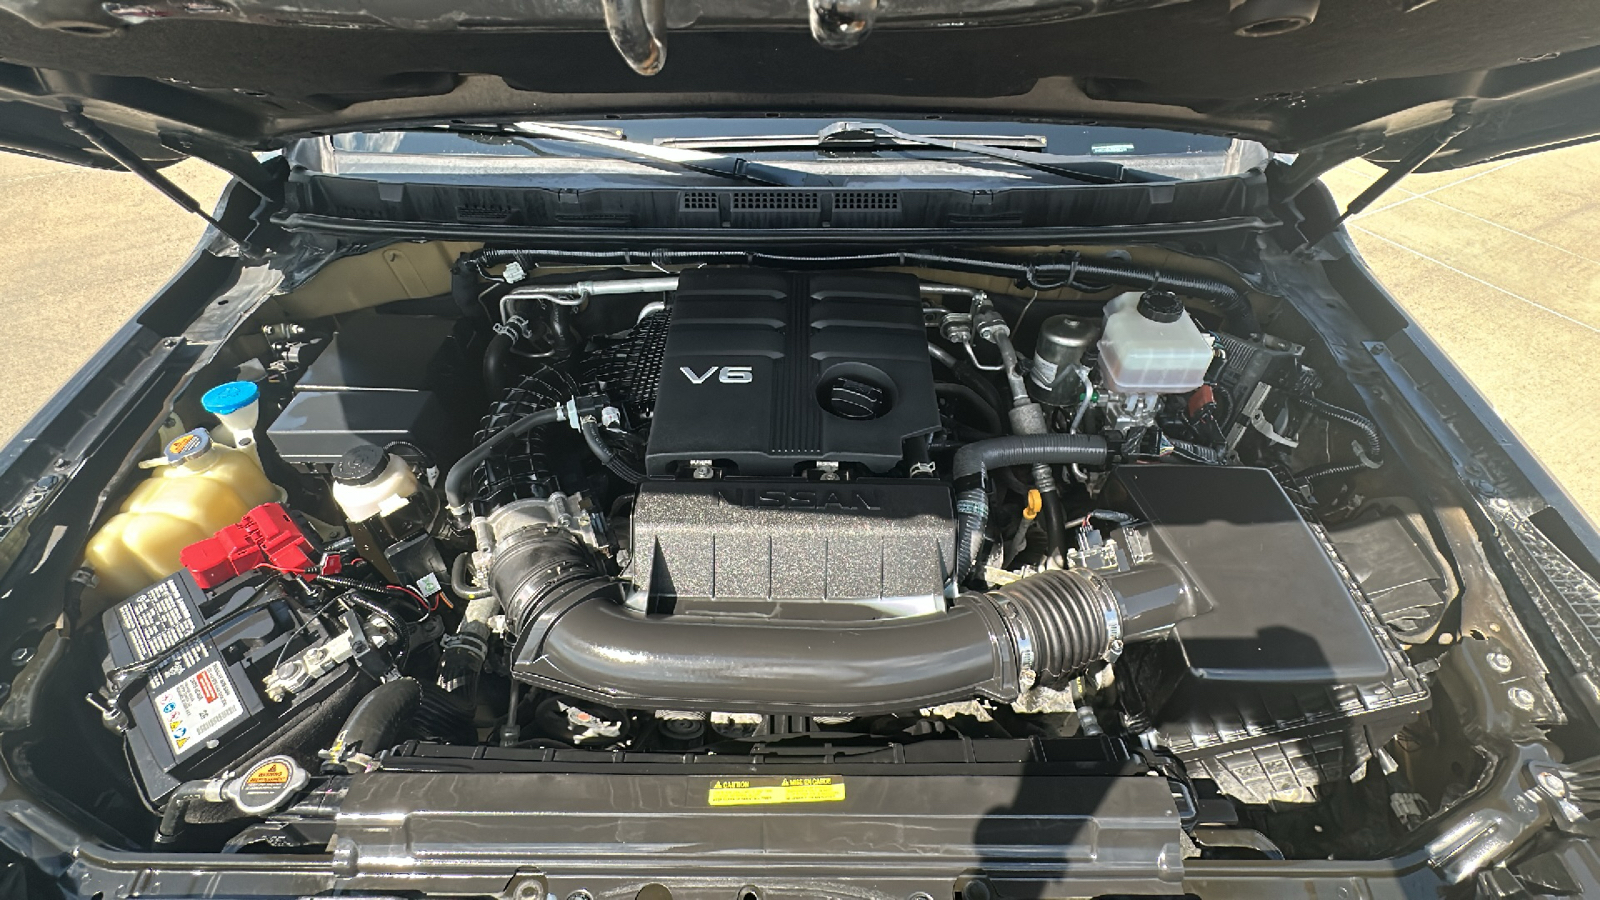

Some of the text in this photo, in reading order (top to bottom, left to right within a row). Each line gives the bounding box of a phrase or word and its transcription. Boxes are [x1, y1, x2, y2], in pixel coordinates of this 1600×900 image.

[679, 366, 753, 384] V6
[713, 488, 882, 511] NISSAN
[722, 780, 750, 789] CAUTION
